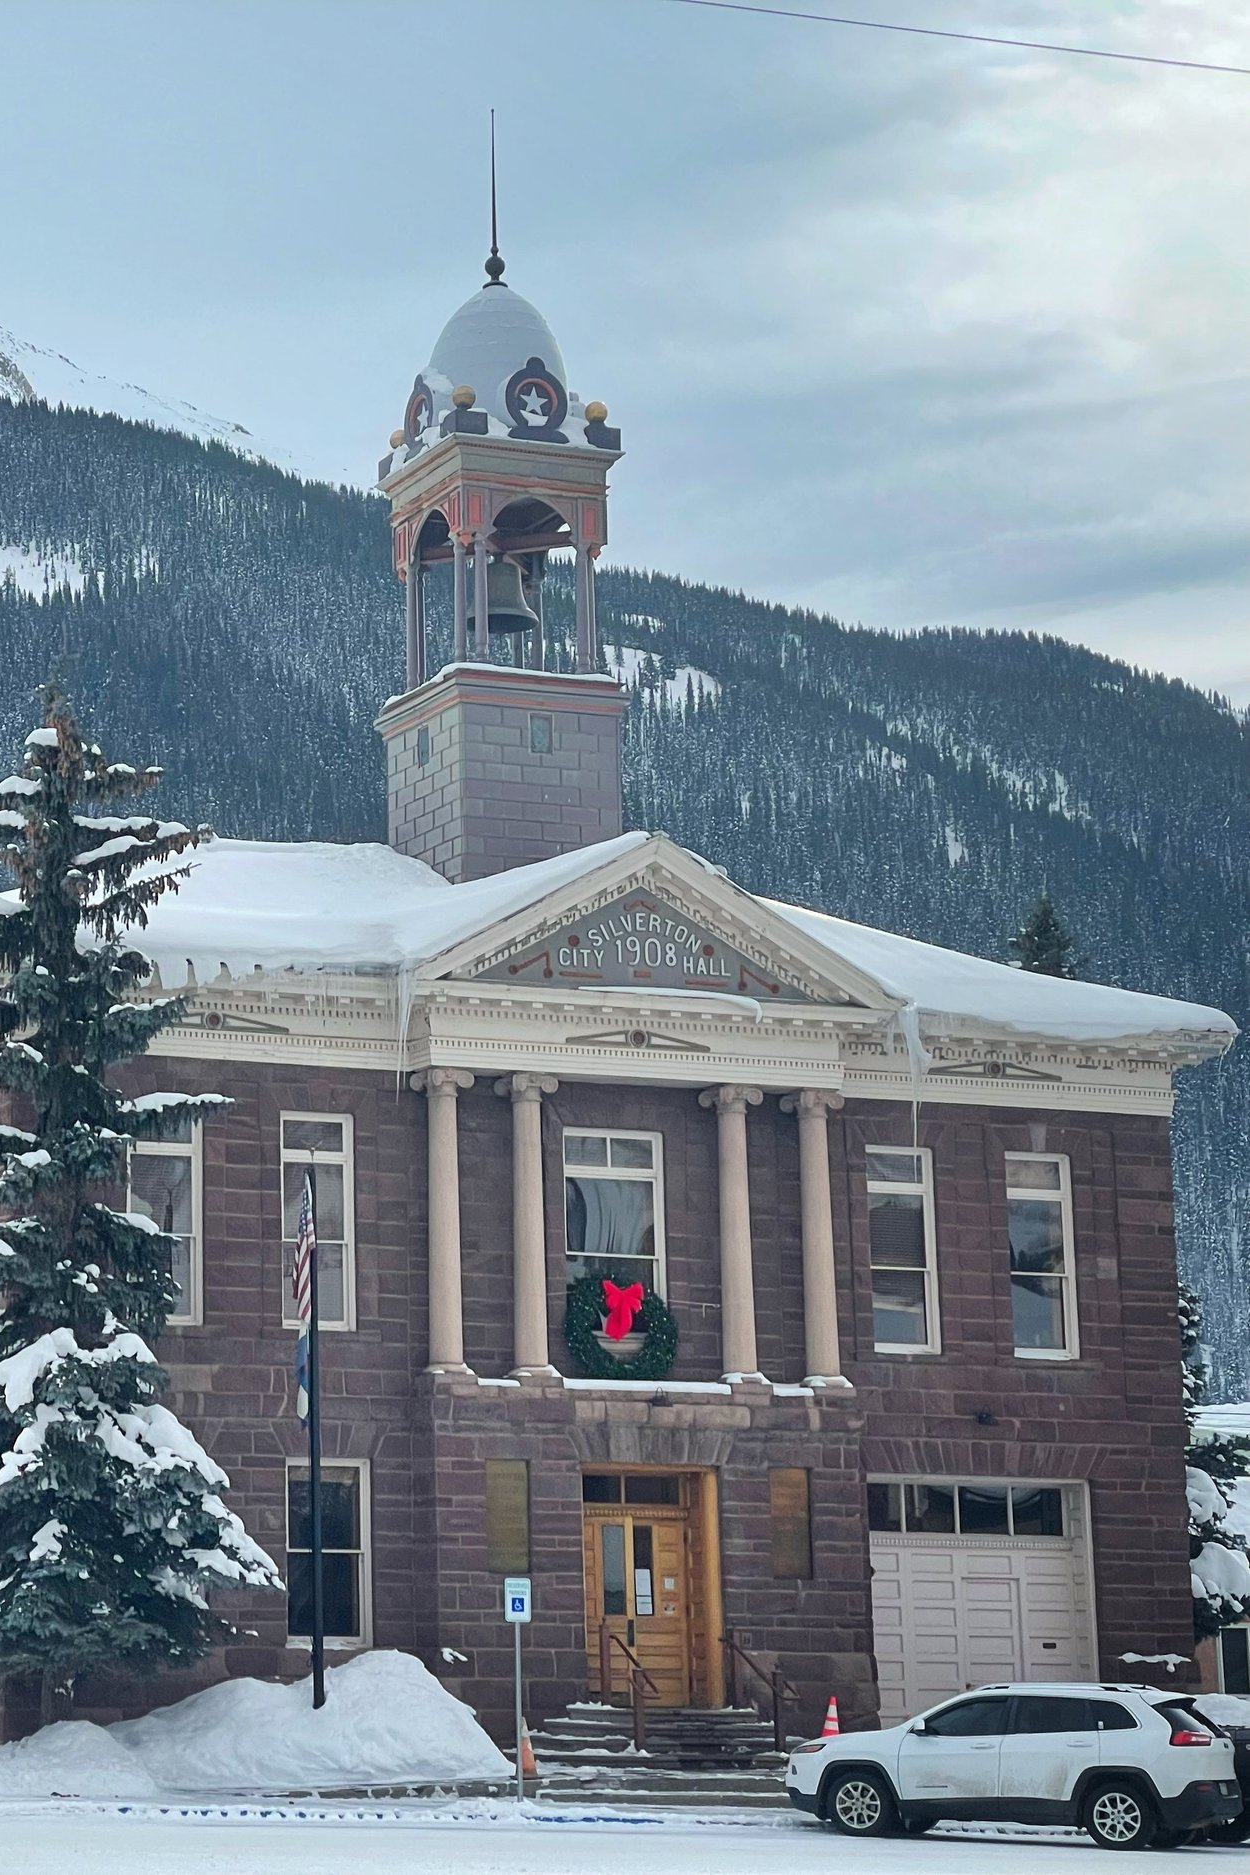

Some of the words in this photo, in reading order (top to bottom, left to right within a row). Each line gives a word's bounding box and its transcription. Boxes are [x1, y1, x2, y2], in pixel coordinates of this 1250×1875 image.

[587, 912, 702, 954] SILVERTON
[558, 947, 605, 968] CITY
[615, 935, 678, 968] 1908
[682, 956, 732, 977] HALL
